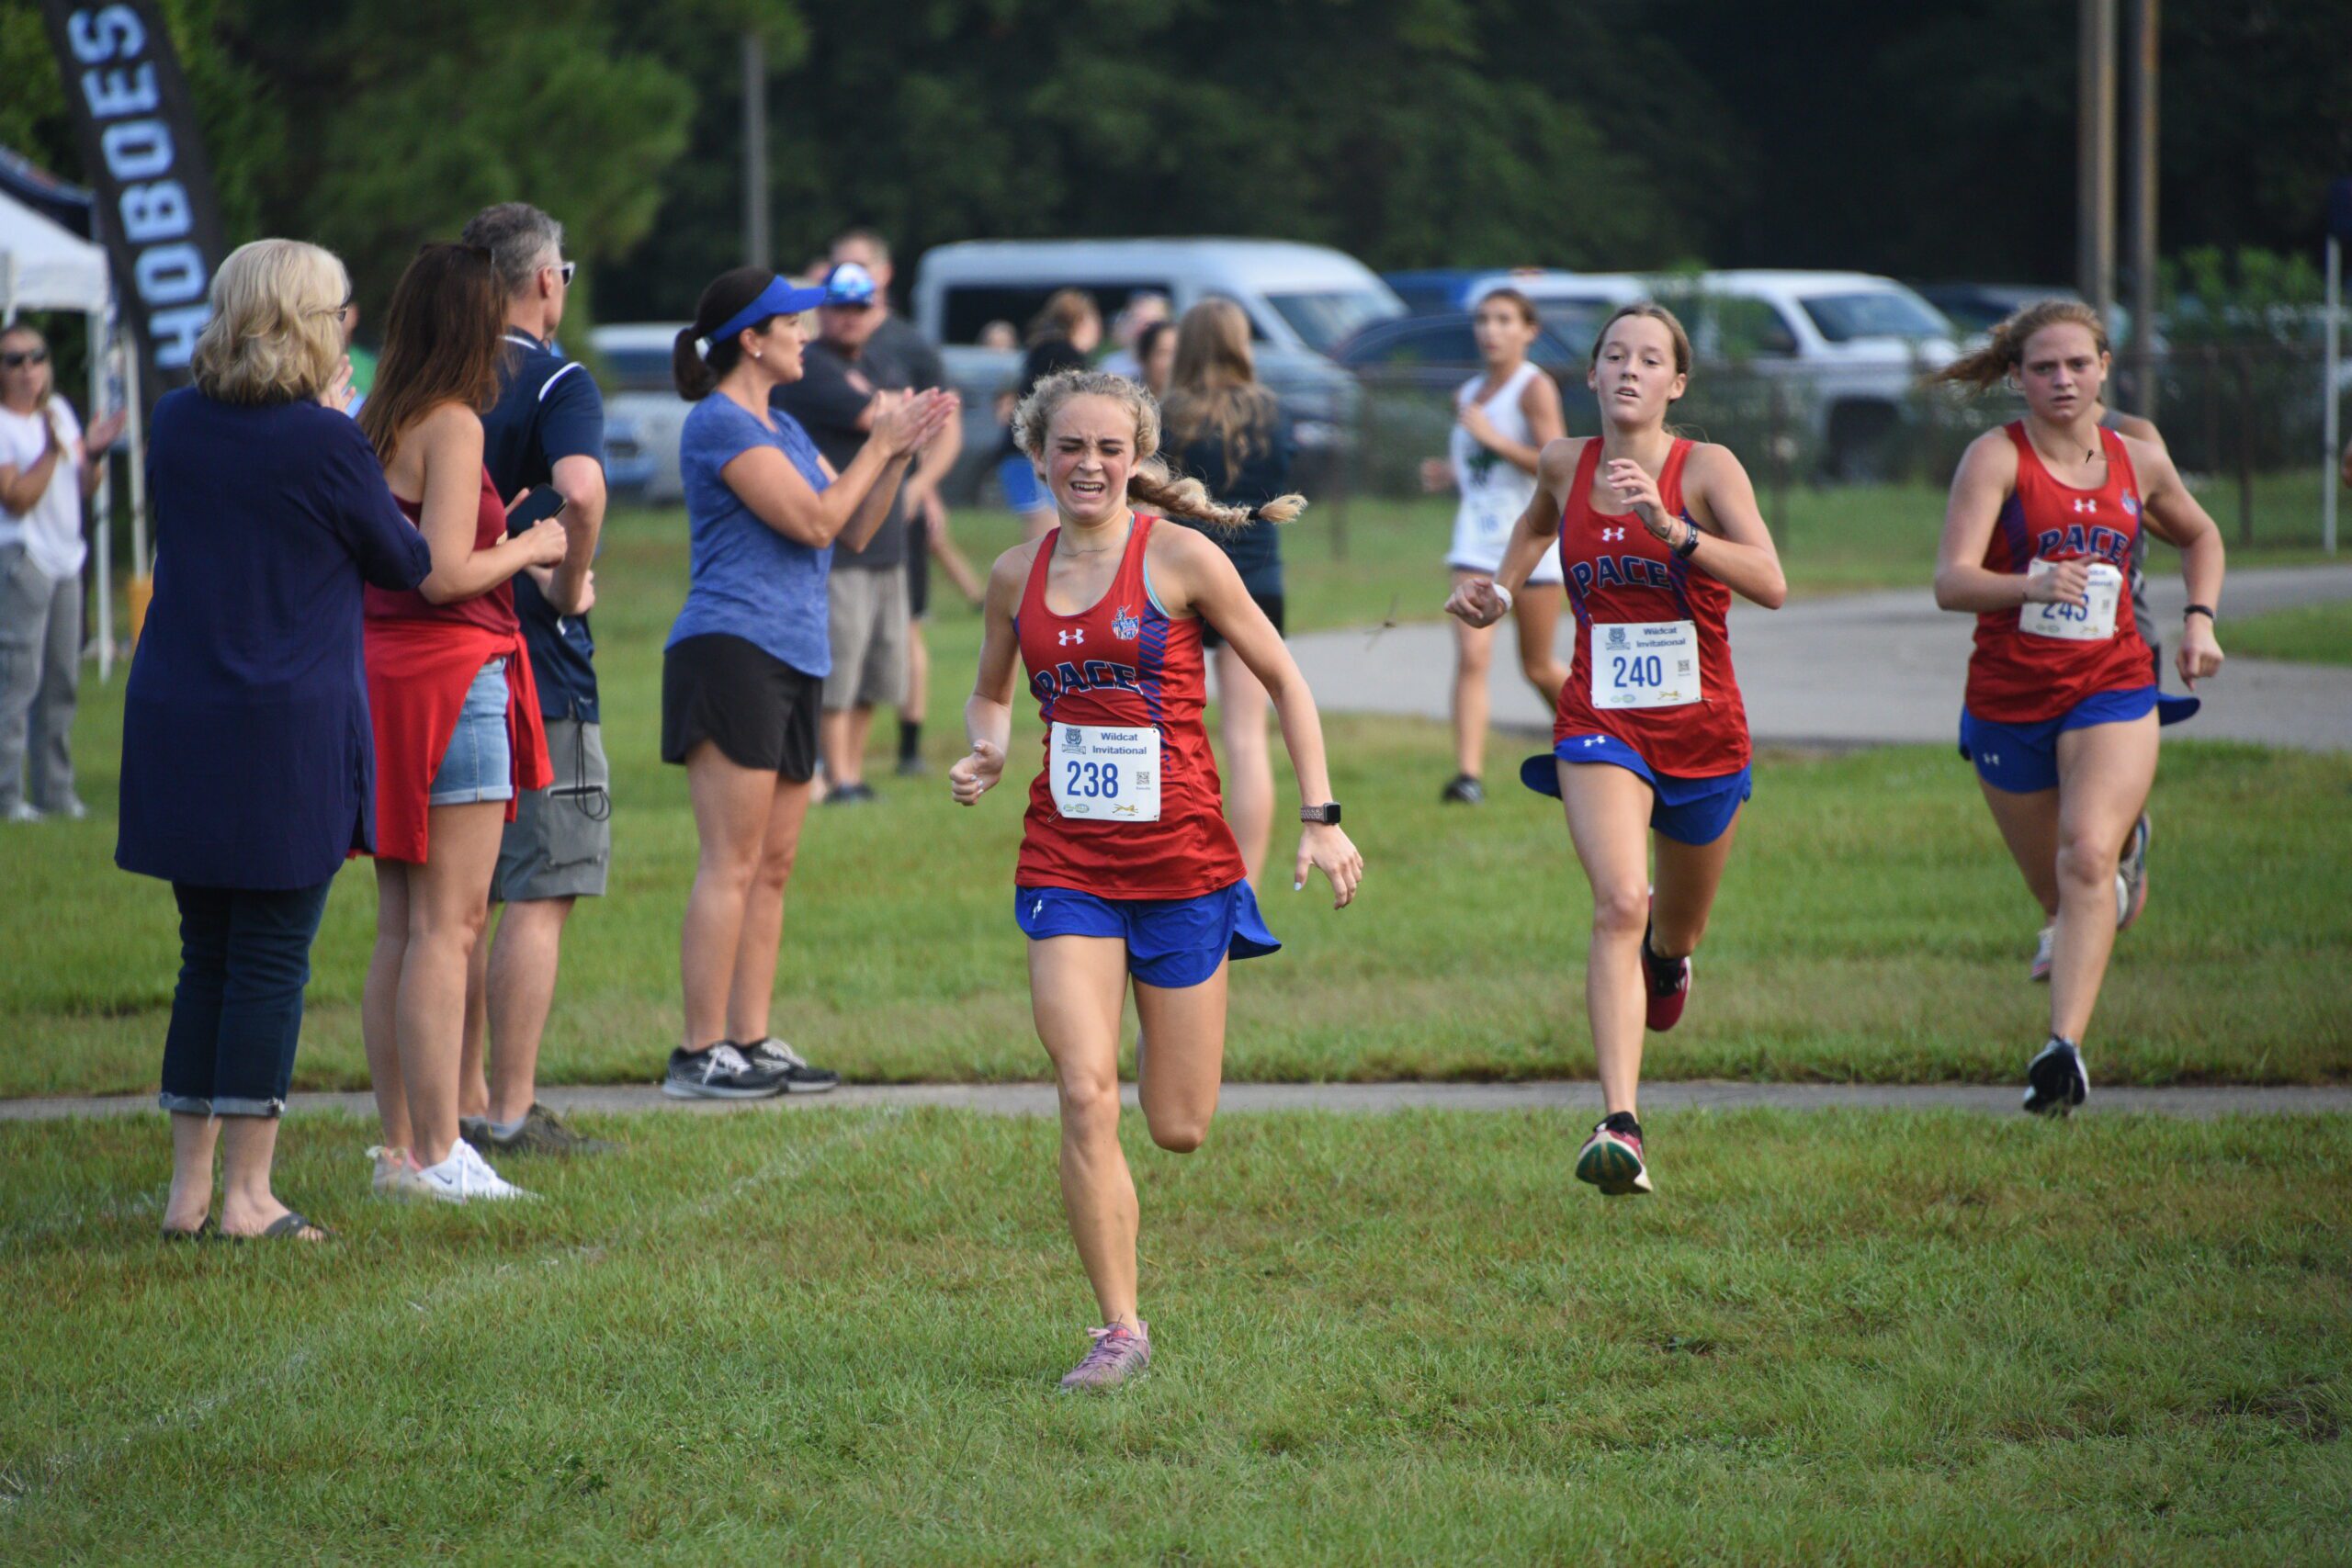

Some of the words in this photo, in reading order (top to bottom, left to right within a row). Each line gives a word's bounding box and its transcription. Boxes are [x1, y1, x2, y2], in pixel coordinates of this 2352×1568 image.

[67, 3, 214, 369] HOBOES
[2037, 523, 2130, 565] PACE
[1570, 555, 1673, 597] PACE
[1636, 638, 1686, 649] Invitational
[1643, 626, 1678, 636] Wildcat
[1035, 660, 1144, 704] PACE
[1612, 655, 1663, 688] 240
[1092, 745, 1148, 755] Invitational
[1101, 732, 1139, 741] Wildcat
[1067, 761, 1119, 798] 238
